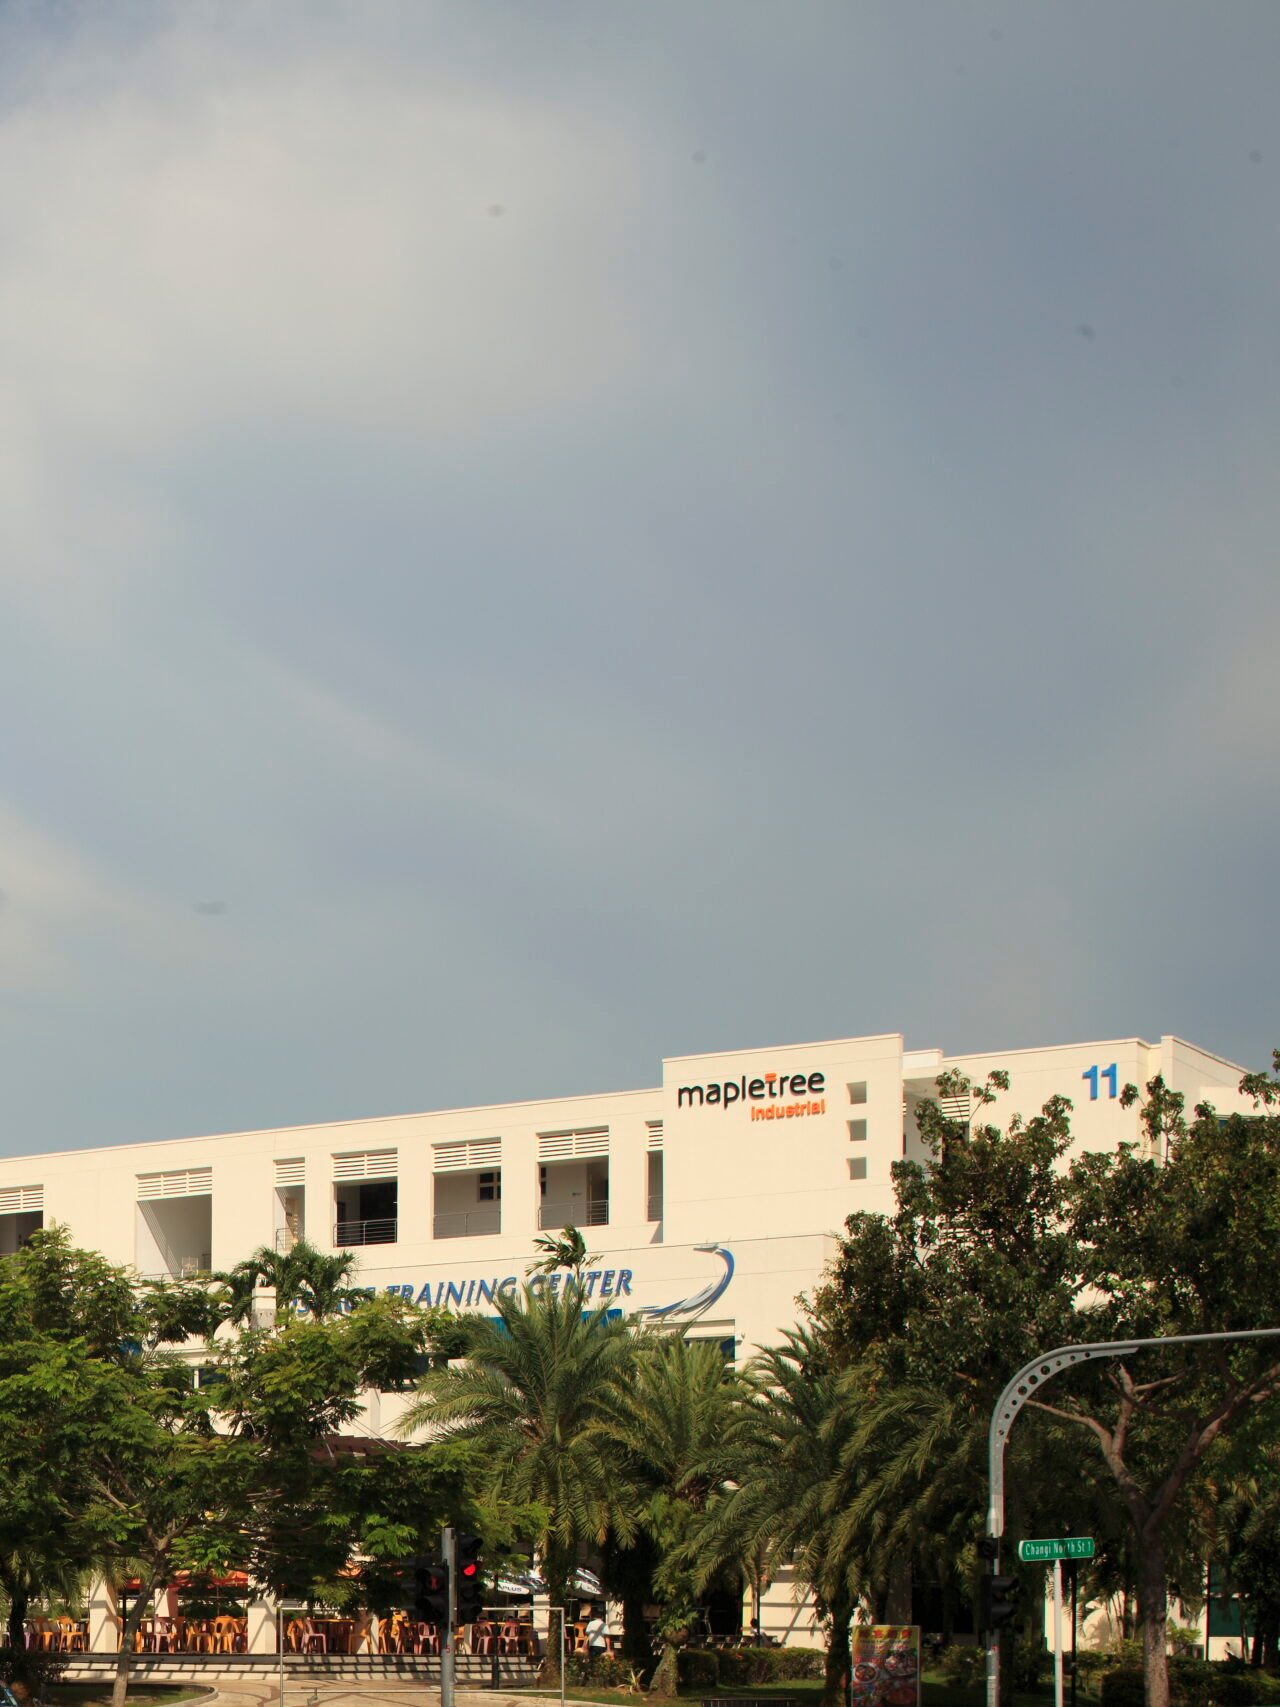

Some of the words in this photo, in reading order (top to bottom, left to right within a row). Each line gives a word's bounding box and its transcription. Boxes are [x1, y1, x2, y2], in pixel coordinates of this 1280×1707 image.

[678, 1072, 825, 1110] mapletree
[1082, 1063, 1117, 1101] 11
[387, 1276, 517, 1308] TRAINING
[528, 1269, 633, 1300] CENTER
[1025, 1542, 1051, 1557] Changi
[1053, 1542, 1075, 1553] North
[1077, 1540, 1085, 1552] St
